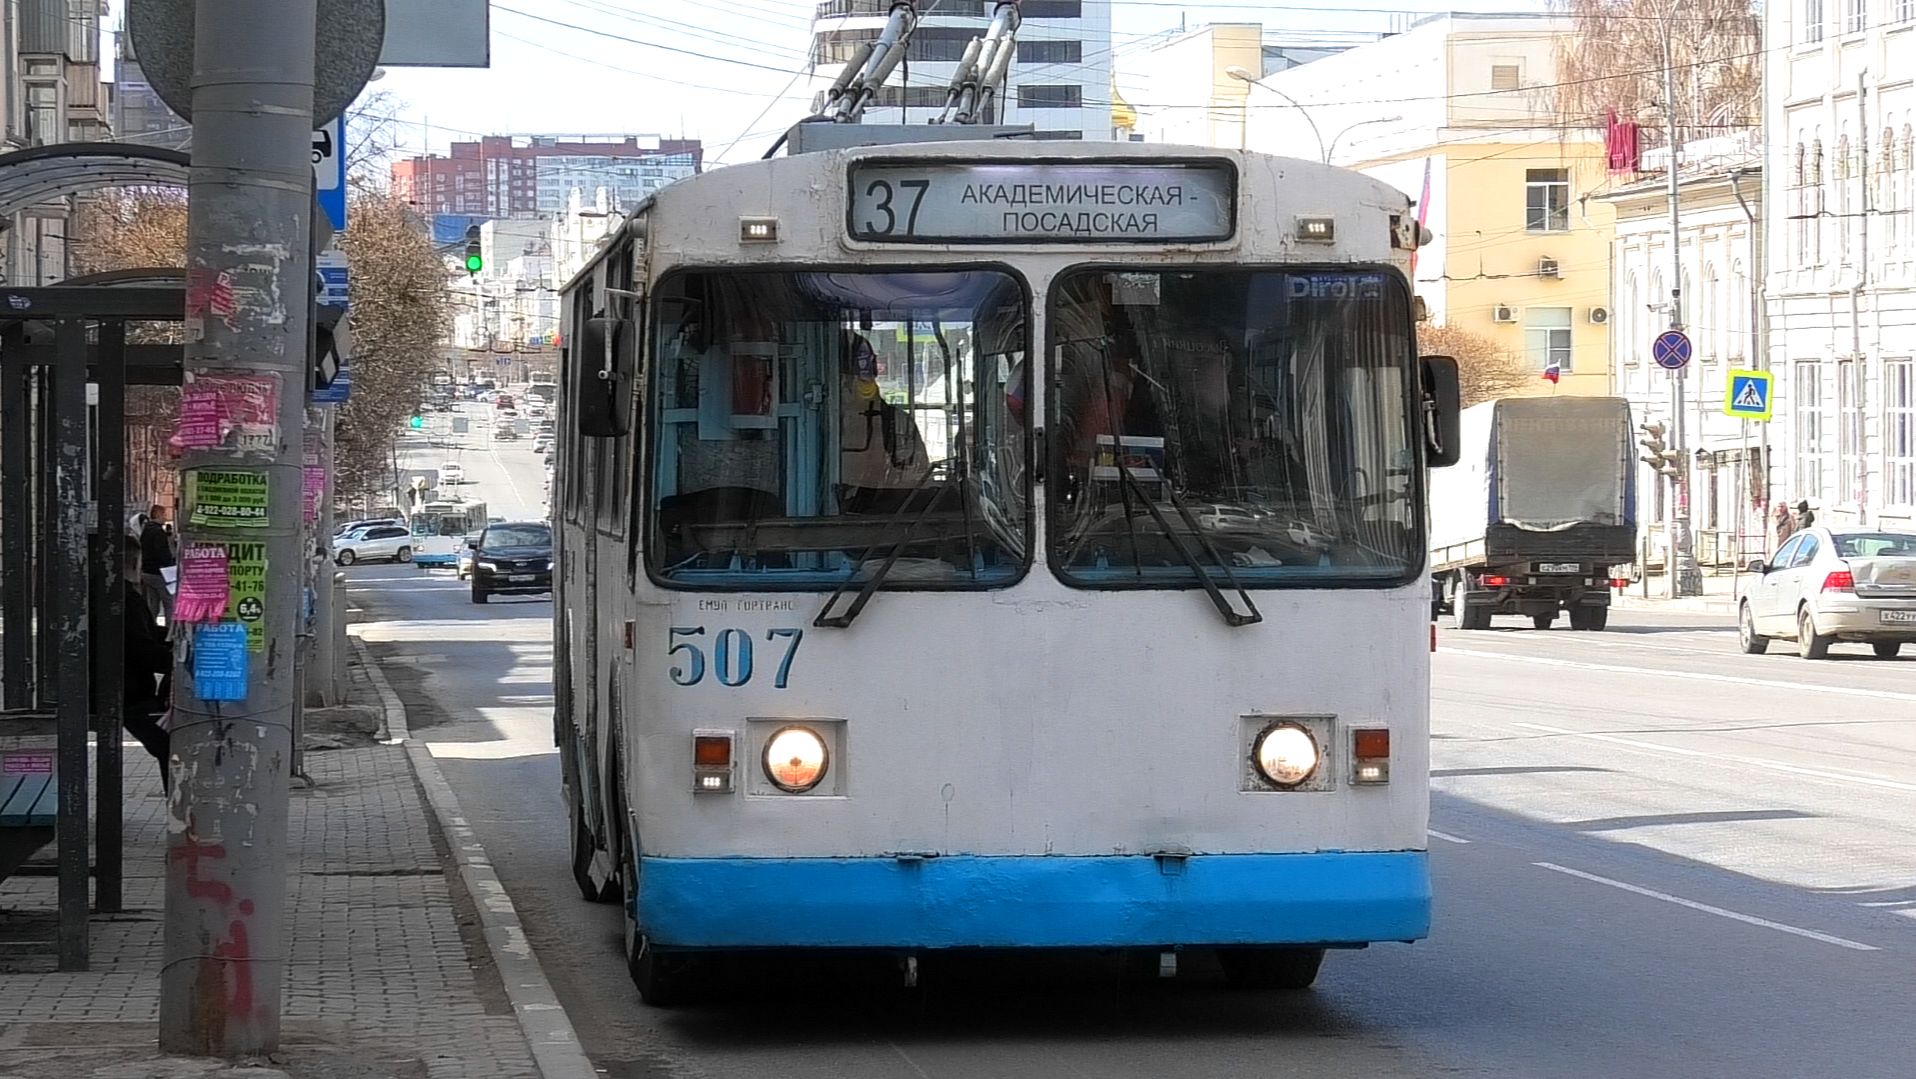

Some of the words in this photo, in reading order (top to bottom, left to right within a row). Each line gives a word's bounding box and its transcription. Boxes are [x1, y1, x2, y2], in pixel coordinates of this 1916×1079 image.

[960, 184, 1182, 208] АКАДЕМИЧЕСКАЯ
[865, 180, 930, 236] 37
[1002, 212, 1158, 233] ПОСАДСКАЯ
[197, 471, 267, 485] ПОДРАБОТКА
[184, 548, 226, 558] РАБОТА
[229, 566, 265, 576] ПОРТУ
[699, 600, 728, 612] ЕМУП
[738, 600, 793, 611] ГОРТРАНС
[196, 624, 244, 632] РАБОТА
[668, 626, 803, 688] 507
